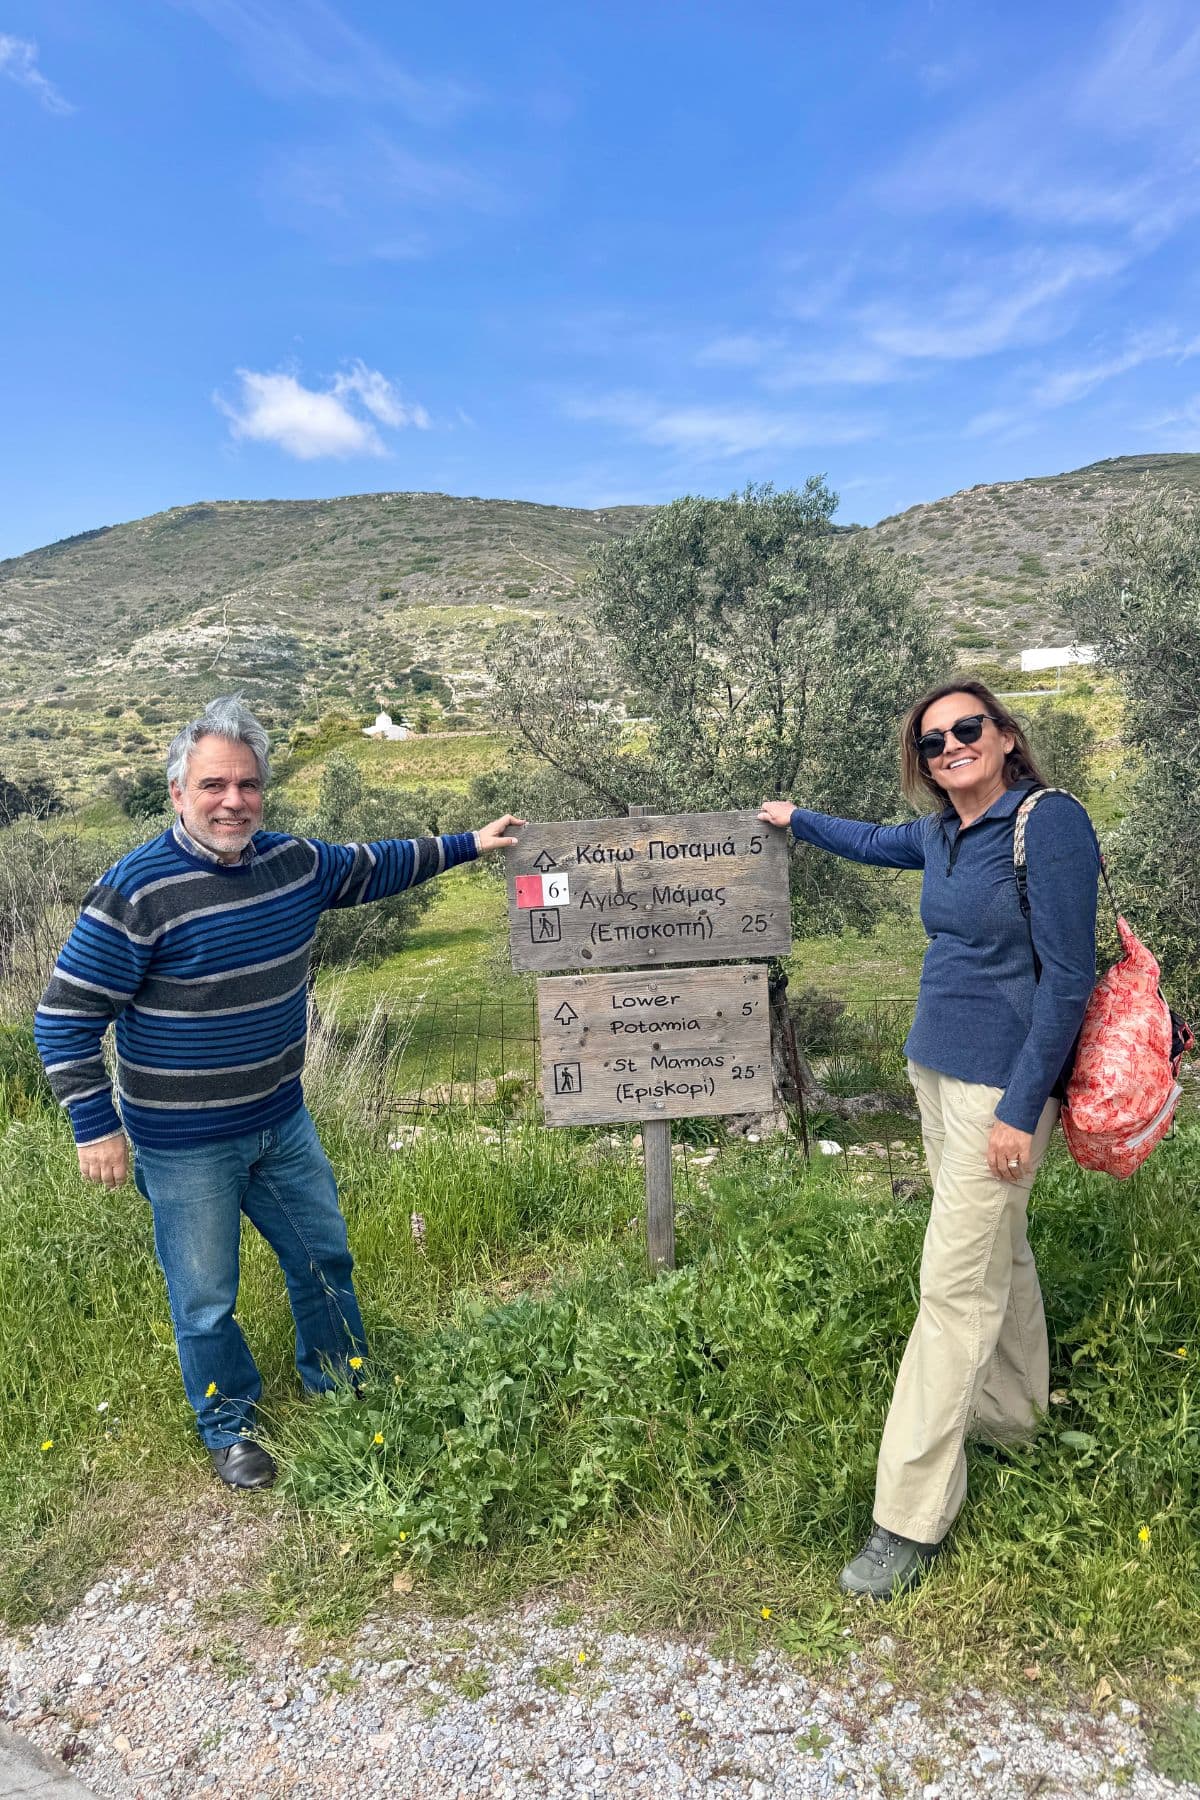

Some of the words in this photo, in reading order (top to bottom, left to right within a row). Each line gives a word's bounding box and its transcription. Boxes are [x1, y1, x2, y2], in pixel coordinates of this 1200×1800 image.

[576, 844, 635, 865] Κάτω
[649, 836, 736, 862] Ποταμιά
[548, 881, 559, 899] 6
[652, 885, 726, 905] Μάμας
[590, 916, 714, 945] (Επισκοπή)
[612, 994, 681, 1009] Lower
[610, 1018, 701, 1035] Potamia
[613, 1058, 638, 1073] St
[651, 1055, 725, 1070] Mamas
[616, 1077, 715, 1103] (Episkopi)
